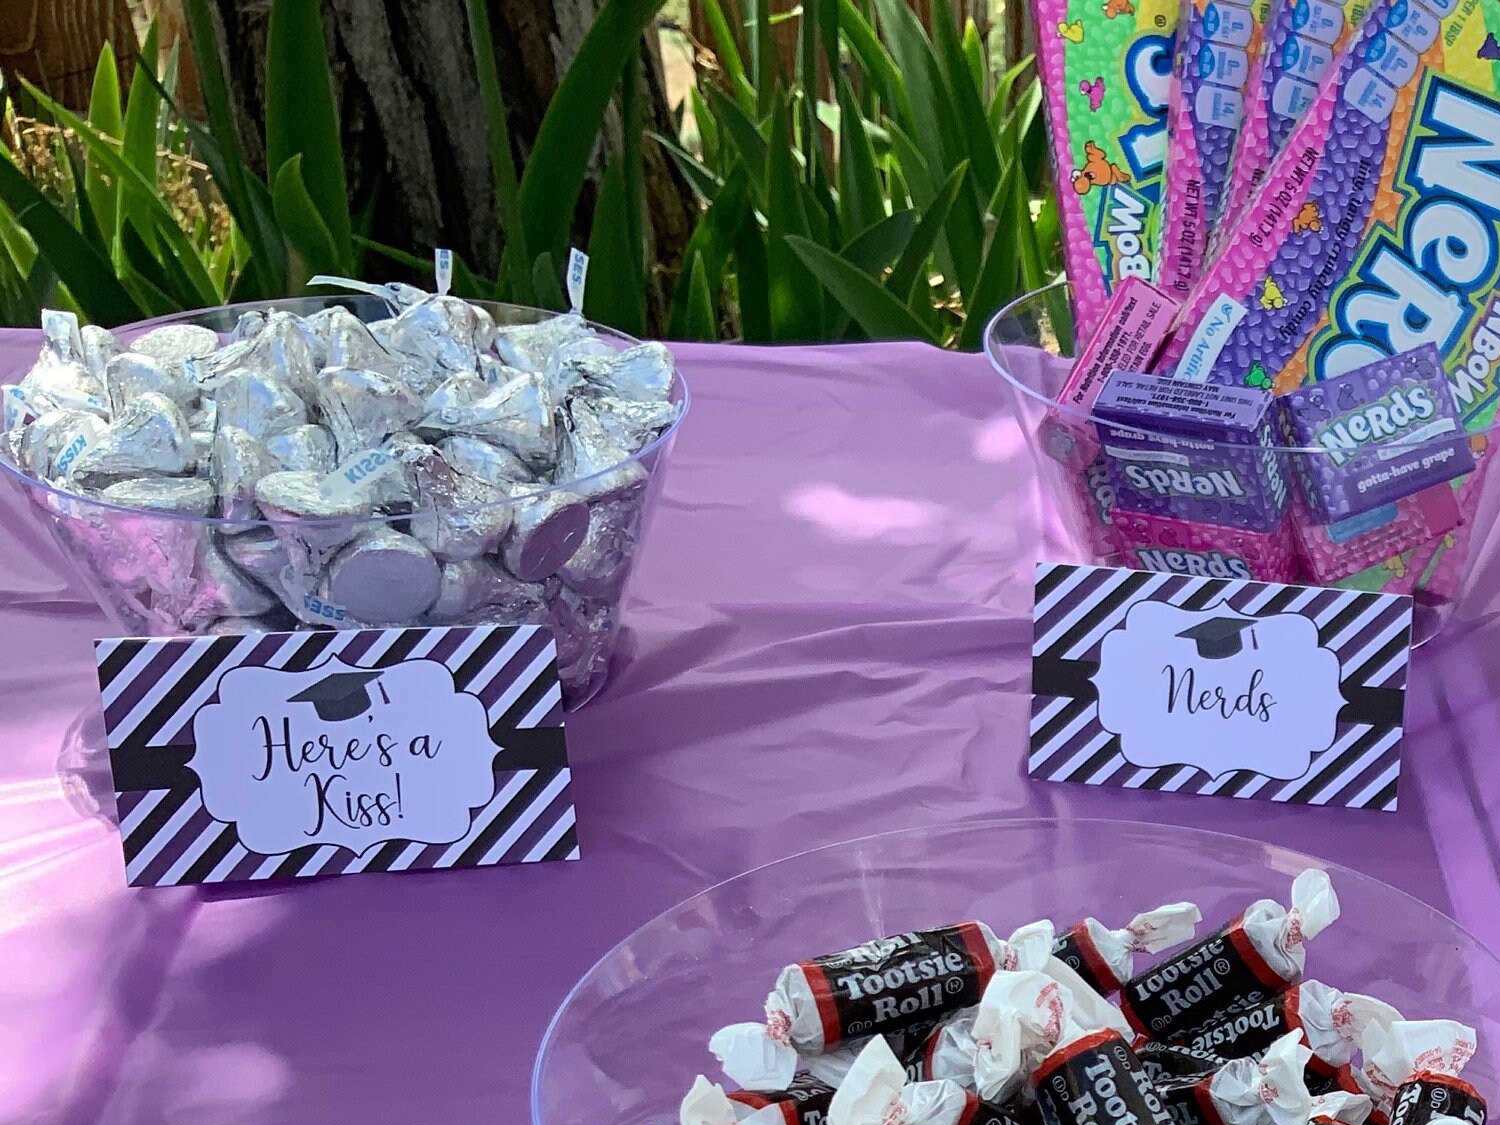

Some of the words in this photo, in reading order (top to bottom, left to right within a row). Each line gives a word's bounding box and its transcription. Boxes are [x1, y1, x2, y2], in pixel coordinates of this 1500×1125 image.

[1290, 165, 1309, 187] WT
[1301, 146, 1320, 171] NET
[1187, 179, 1201, 202] NET
[1274, 190, 1293, 209] OZ
[1284, 181, 1298, 194] 5
[1183, 201, 1198, 220] WT
[1337, 198, 1366, 245] tangy
[1181, 228, 1196, 246] OZ
[1308, 240, 1342, 304] crunchy
[1204, 316, 1226, 337] No
[1279, 298, 1313, 342] candy
[1356, 462, 1420, 493] gotta-have
[1421, 446, 1456, 470] grape
[1161, 664, 1279, 723] Nerds
[251, 714, 395, 782] Here's
[408, 735, 443, 762] a
[302, 771, 405, 837] Kiss!
[836, 950, 965, 1001] Tootsie
[1191, 1003, 1281, 1053] Tootsie
